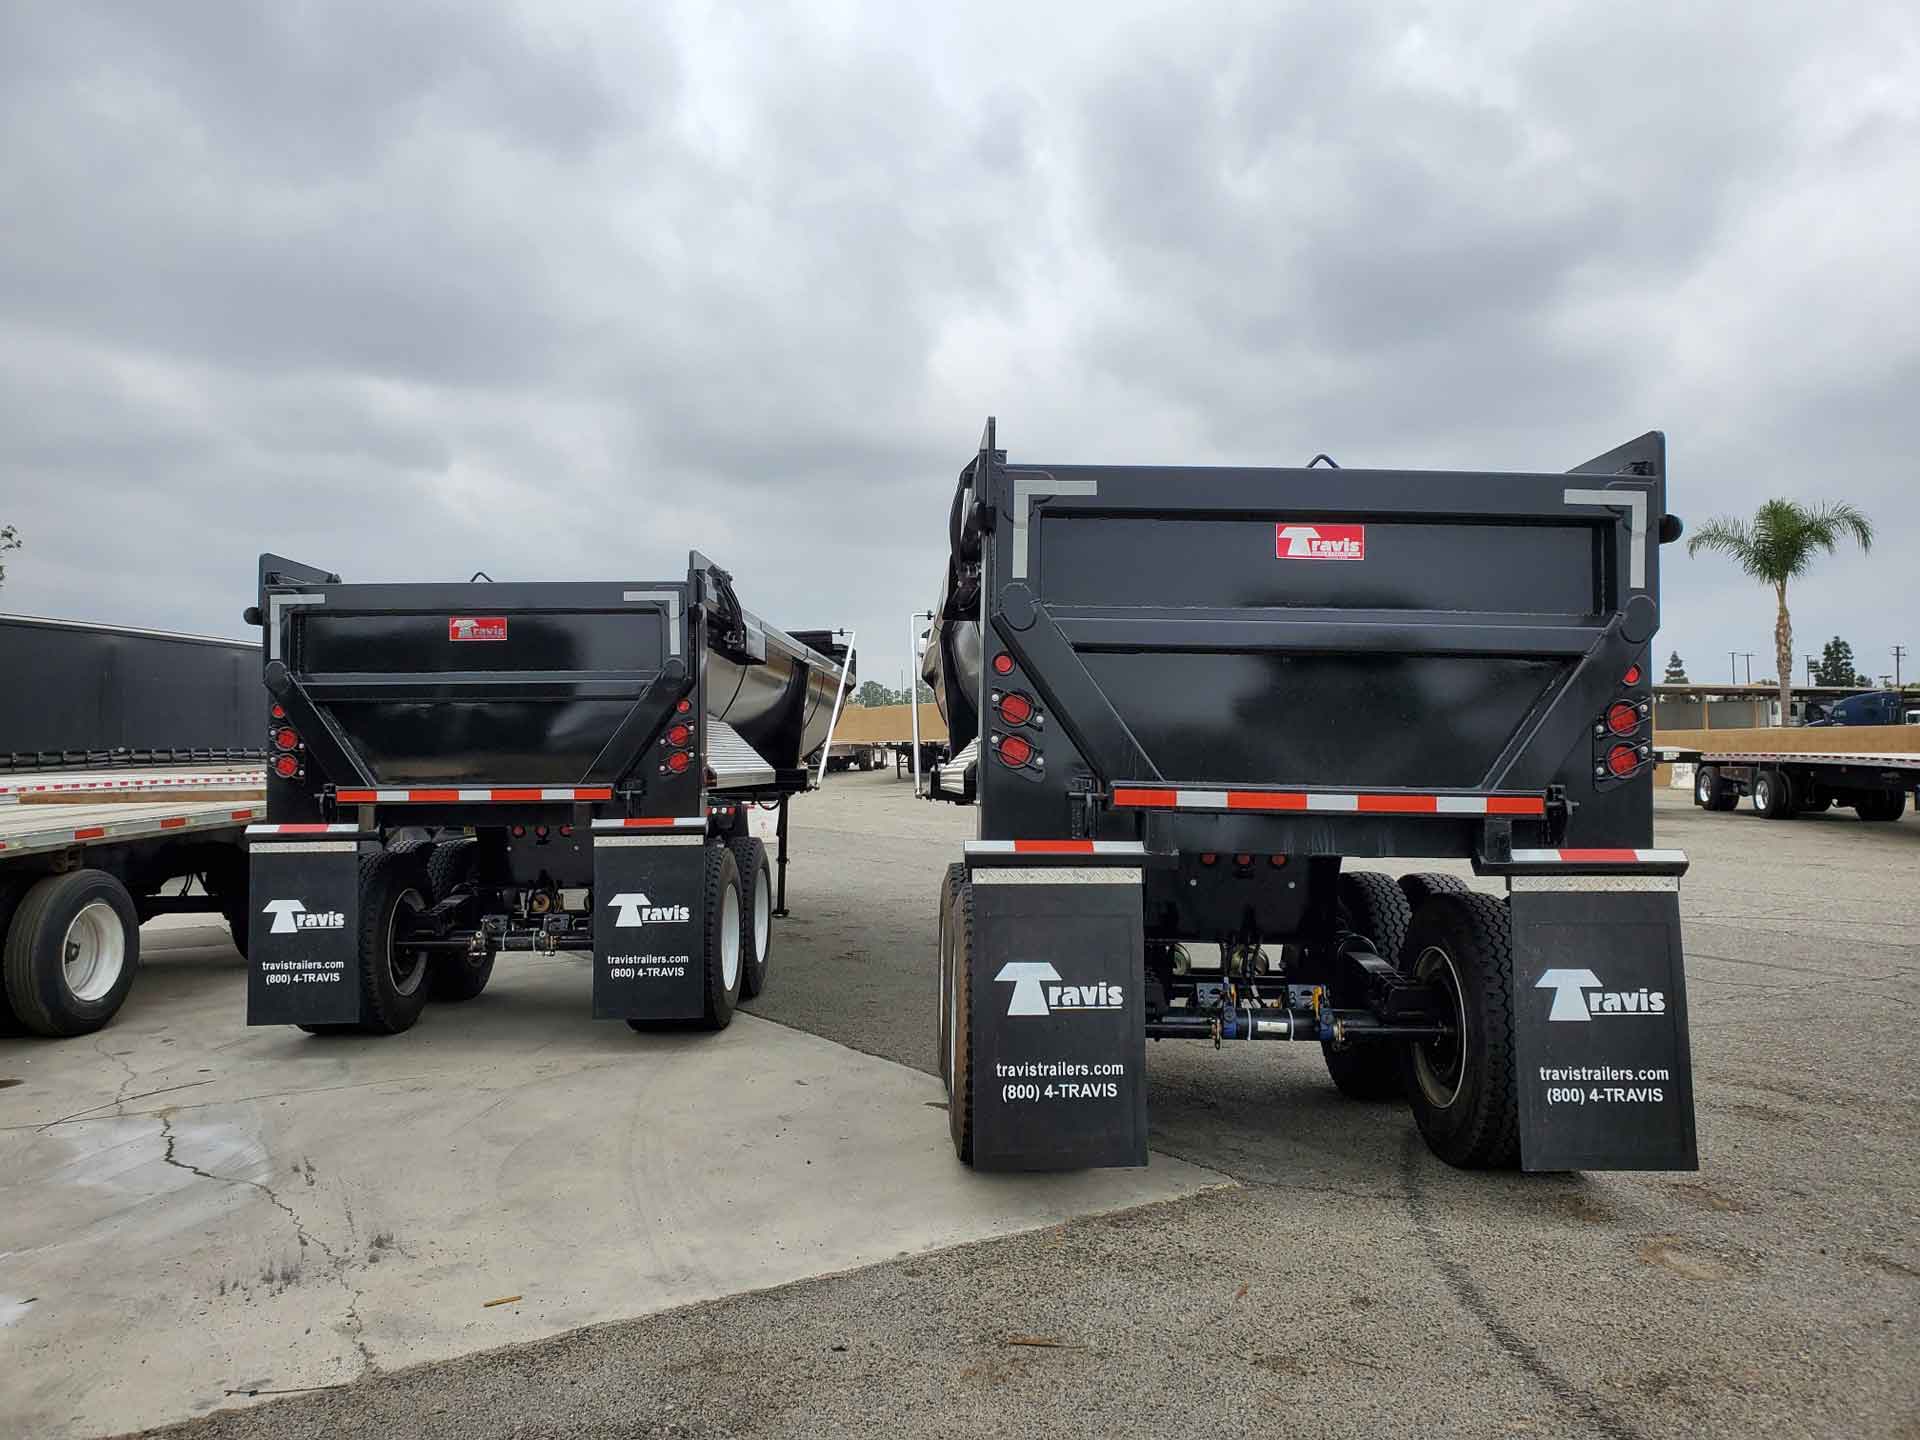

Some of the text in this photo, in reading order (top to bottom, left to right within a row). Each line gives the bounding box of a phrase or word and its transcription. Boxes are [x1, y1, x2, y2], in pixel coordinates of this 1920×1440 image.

[1278, 527, 1361, 556] Travis
[262, 899, 345, 933] Travis
[607, 893, 690, 927] Travis
[262, 960, 344, 970] travistrailers.com
[607, 954, 689, 964] travistrailers.com
[266, 972, 340, 985] (800) 4-TRAVIS
[610, 967, 685, 979] (800) 4-TRAVIS
[994, 962, 1123, 1016] Travis
[1534, 968, 1666, 1021] Travis
[996, 1061, 1124, 1077] travistrailers.com
[1539, 1066, 1669, 1081] travistrailers.com
[1002, 1083, 1118, 1103] (800) 4-TRAVIS
[1547, 1087, 1664, 1105] (800) 4-TRAVIS
